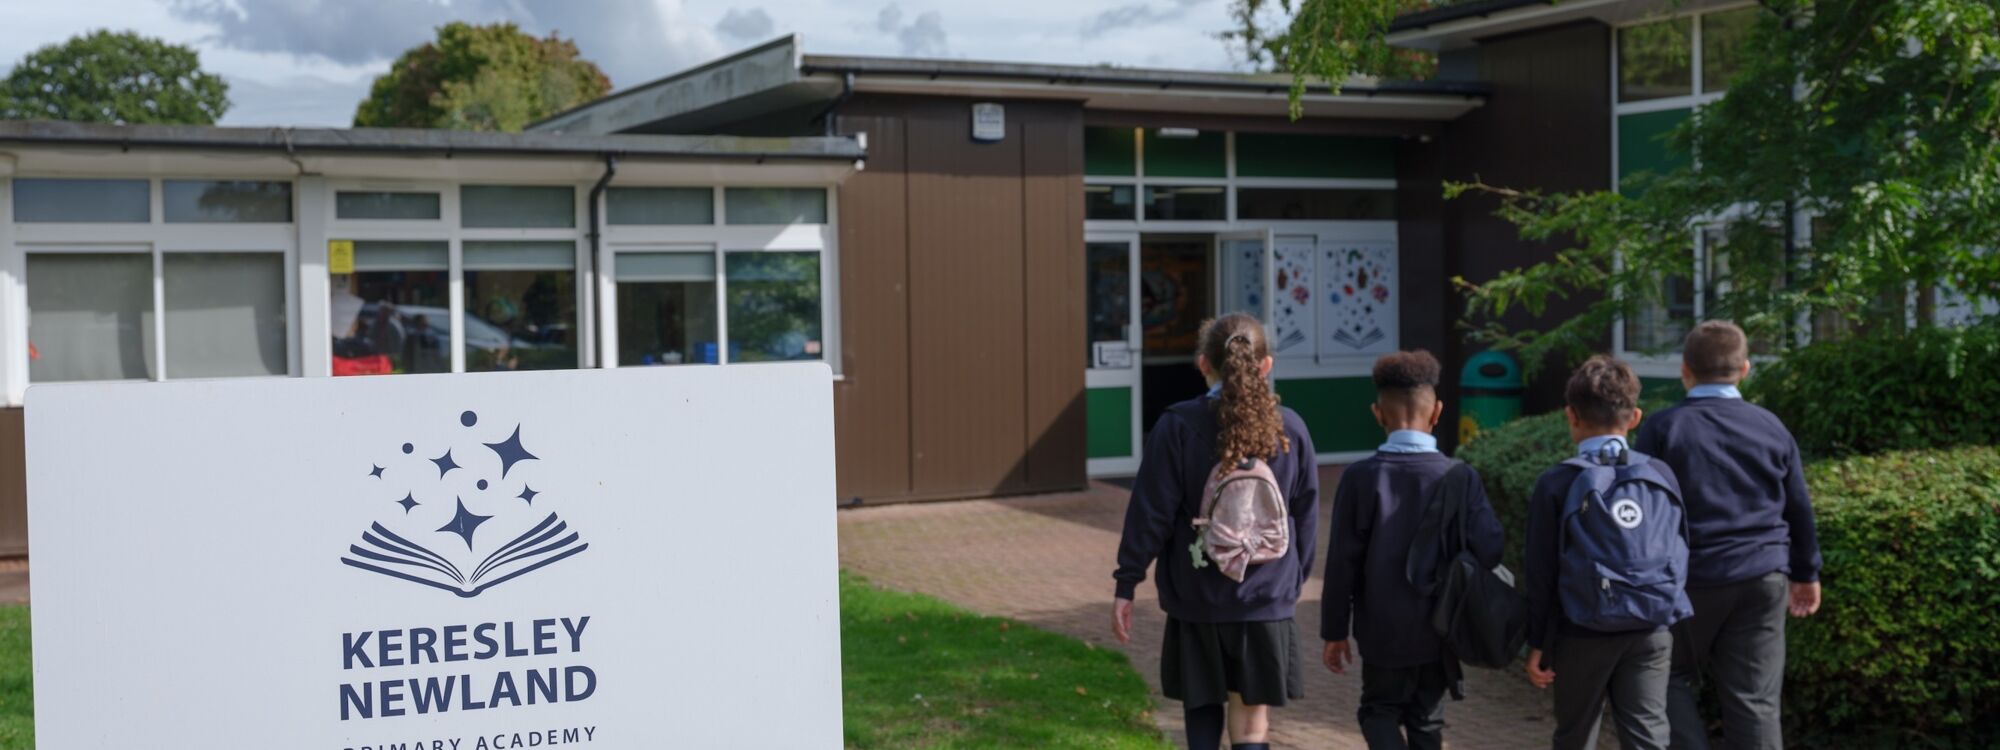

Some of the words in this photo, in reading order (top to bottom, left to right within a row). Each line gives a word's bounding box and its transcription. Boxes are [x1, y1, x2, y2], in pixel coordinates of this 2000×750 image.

[342, 616, 591, 670] KERESLEY
[339, 665, 597, 721] NEWLAND
[343, 737, 461, 750] MARY
[475, 726, 596, 750] ACADEMY
